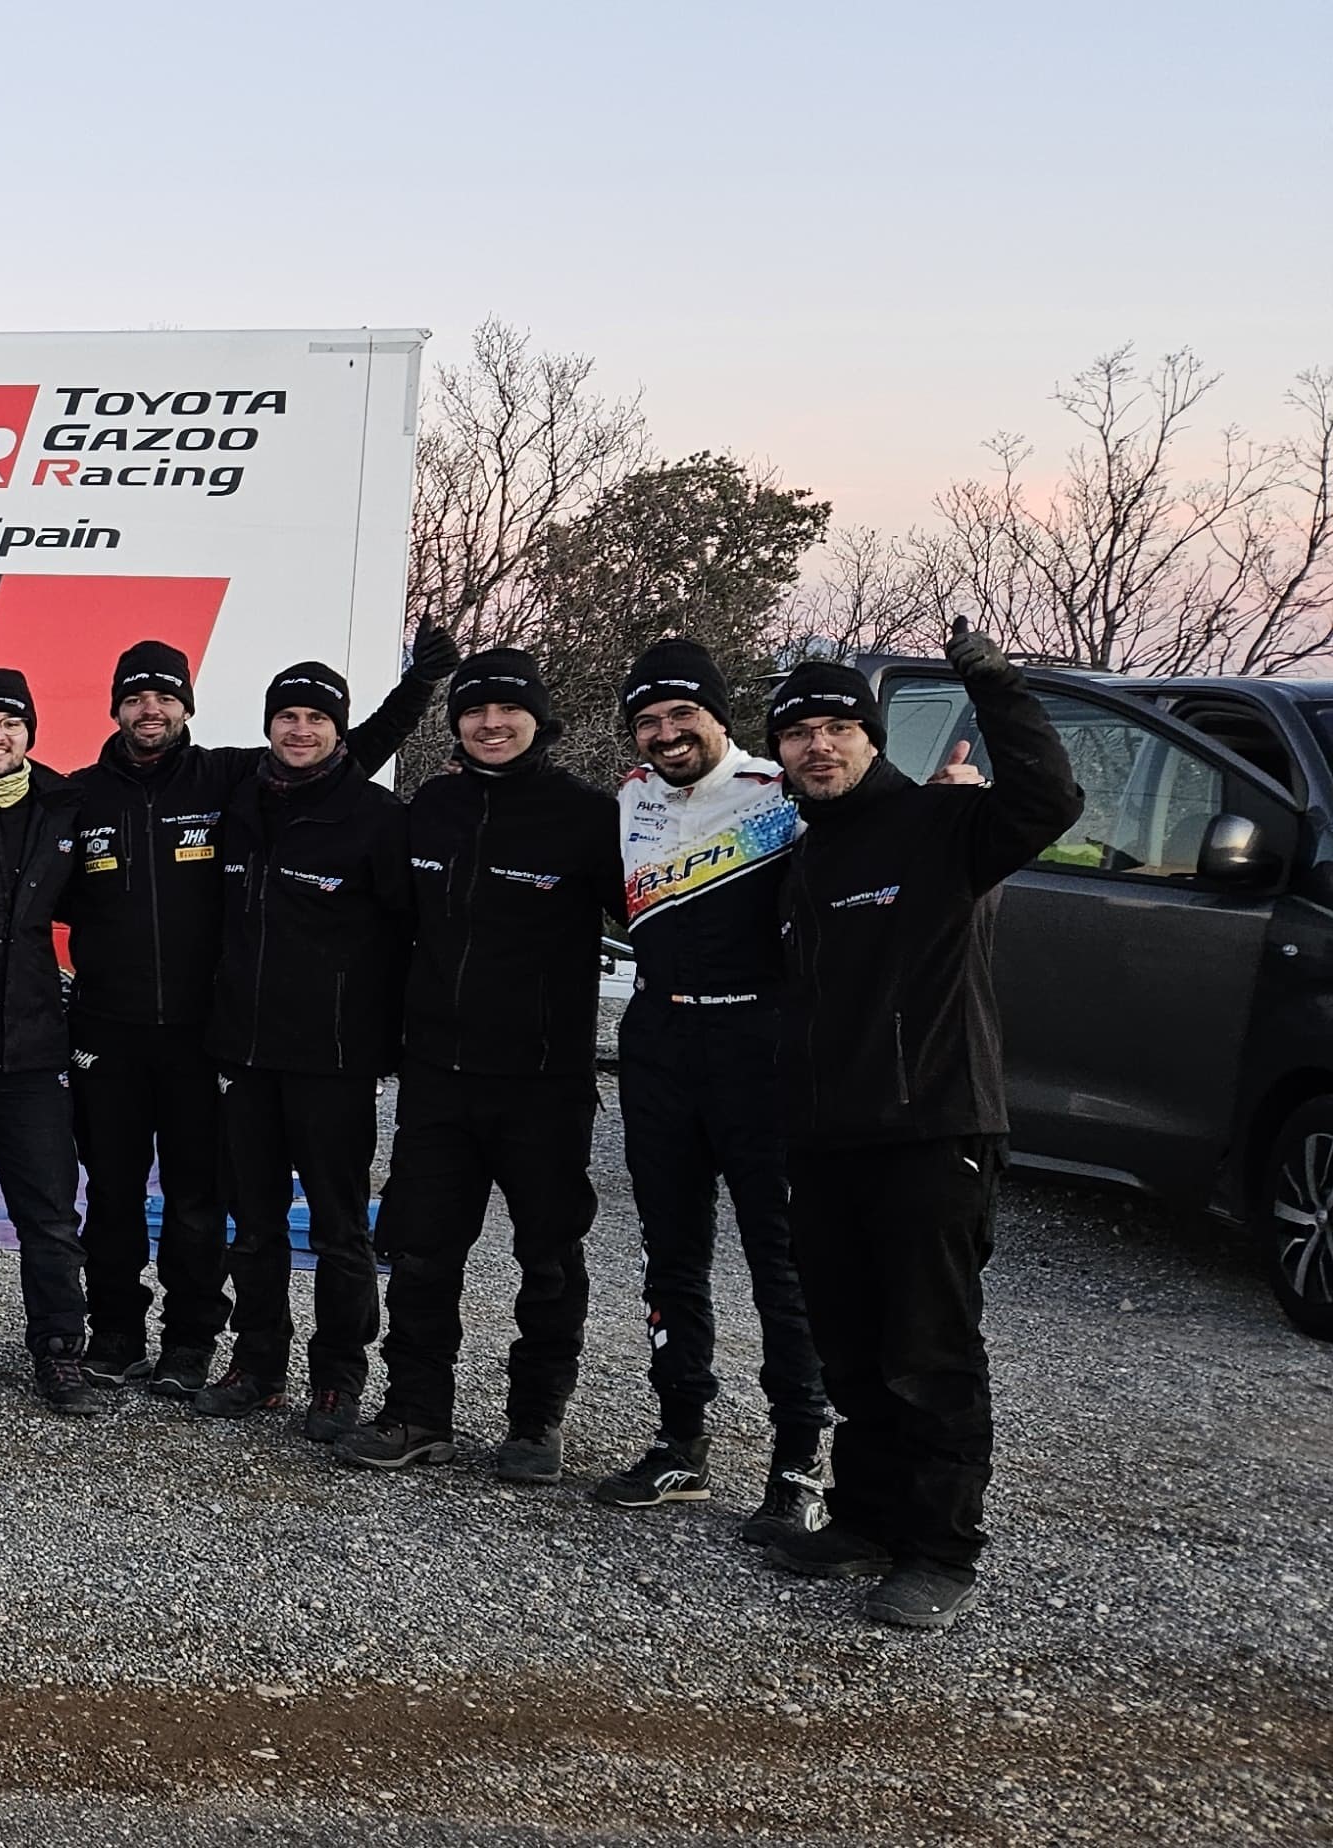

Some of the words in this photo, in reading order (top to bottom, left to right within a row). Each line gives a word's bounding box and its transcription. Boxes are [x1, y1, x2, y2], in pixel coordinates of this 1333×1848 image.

[54, 387, 287, 416] TOYOTA
[42, 424, 259, 452] GAZOO
[32, 458, 244, 496] Racing
[178, 828, 210, 846] JHK
